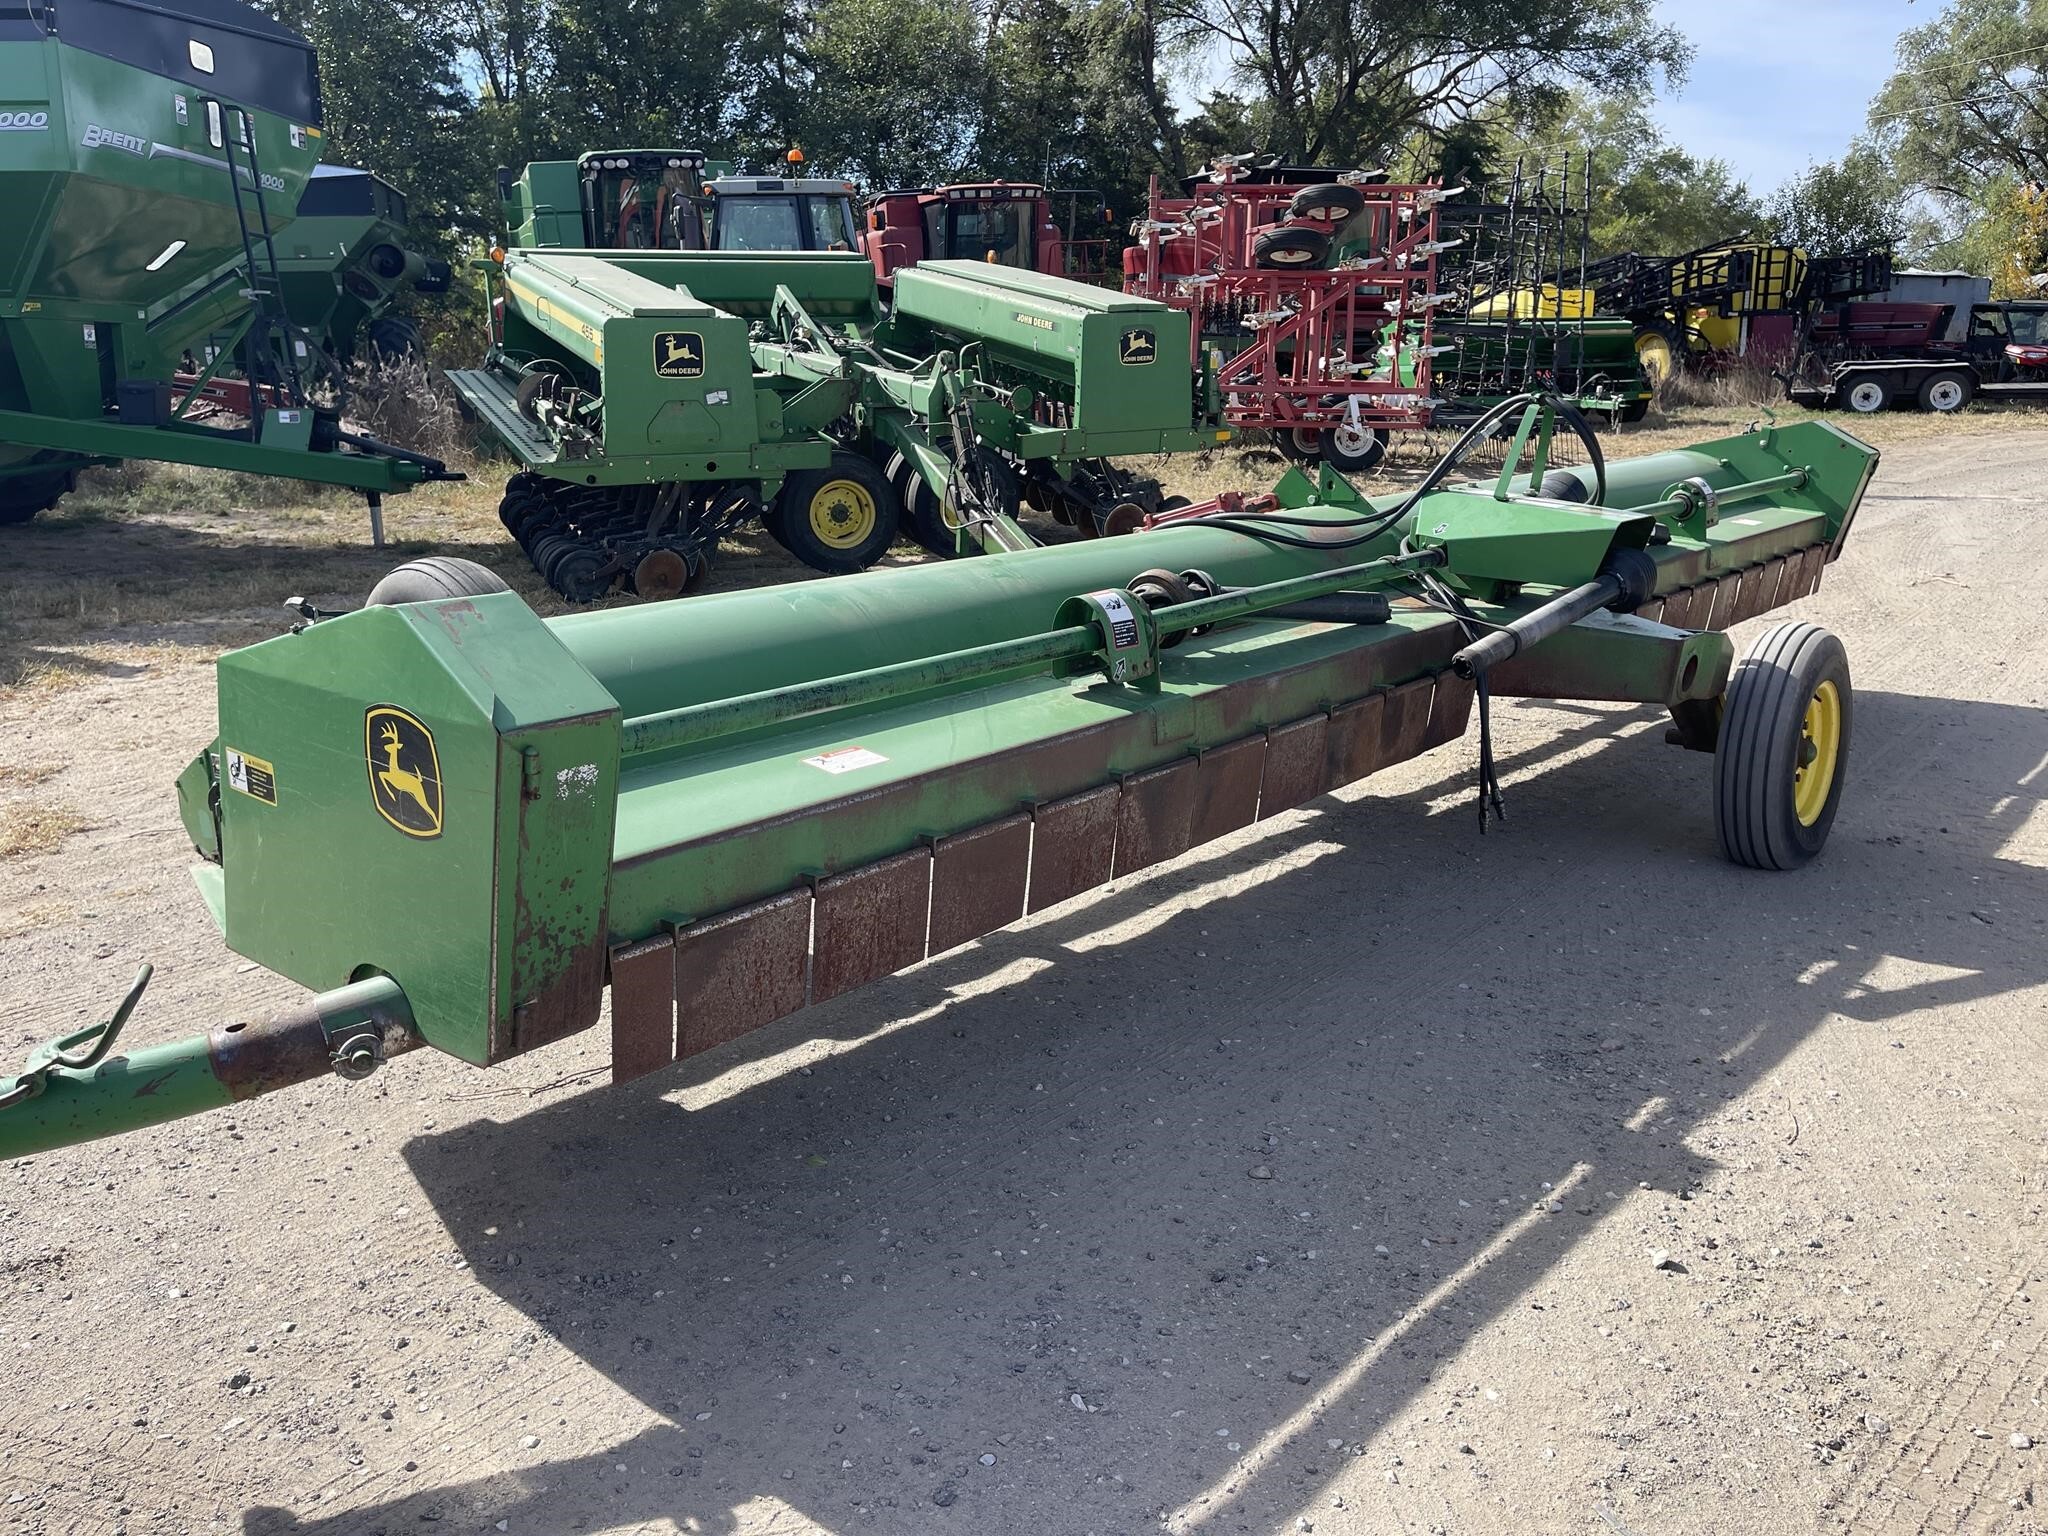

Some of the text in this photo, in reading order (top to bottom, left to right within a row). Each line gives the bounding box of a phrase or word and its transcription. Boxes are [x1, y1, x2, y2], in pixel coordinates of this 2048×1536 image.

[260, 173, 285, 189] 1000
[1016, 313, 1054, 331] JOHN DEERE
[678, 367, 701, 375] DEERE
